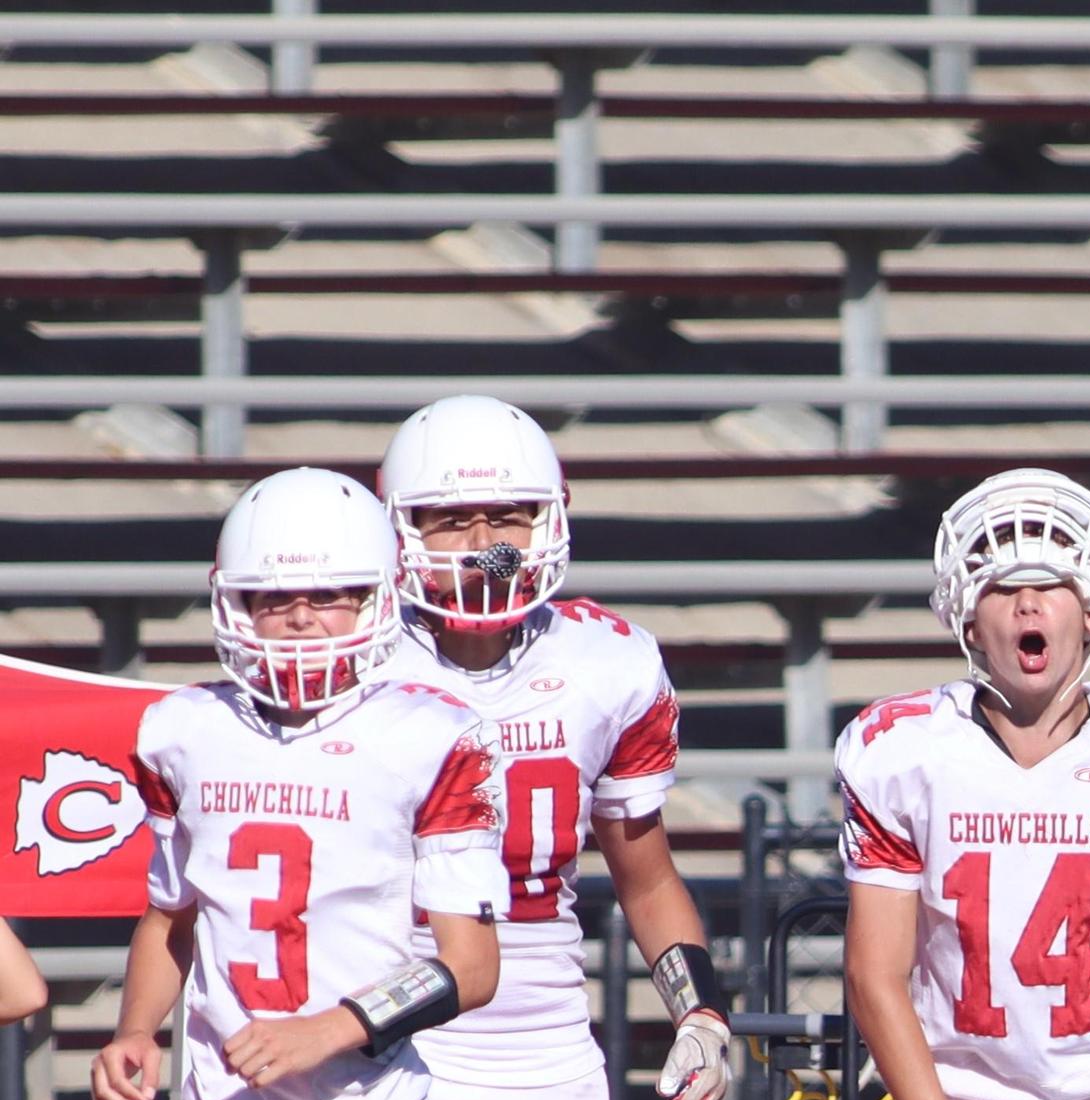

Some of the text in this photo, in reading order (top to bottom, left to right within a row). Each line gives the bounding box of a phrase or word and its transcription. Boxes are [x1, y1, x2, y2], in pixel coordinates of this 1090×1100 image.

[457, 467, 497, 479] Riddell
[276, 553, 317, 564] Riddell
[500, 719, 567, 752] HILLA
[42, 781, 122, 843] C
[200, 781, 351, 821] CHOWCHILLA
[504, 757, 581, 923] 0
[228, 822, 314, 1013] 3
